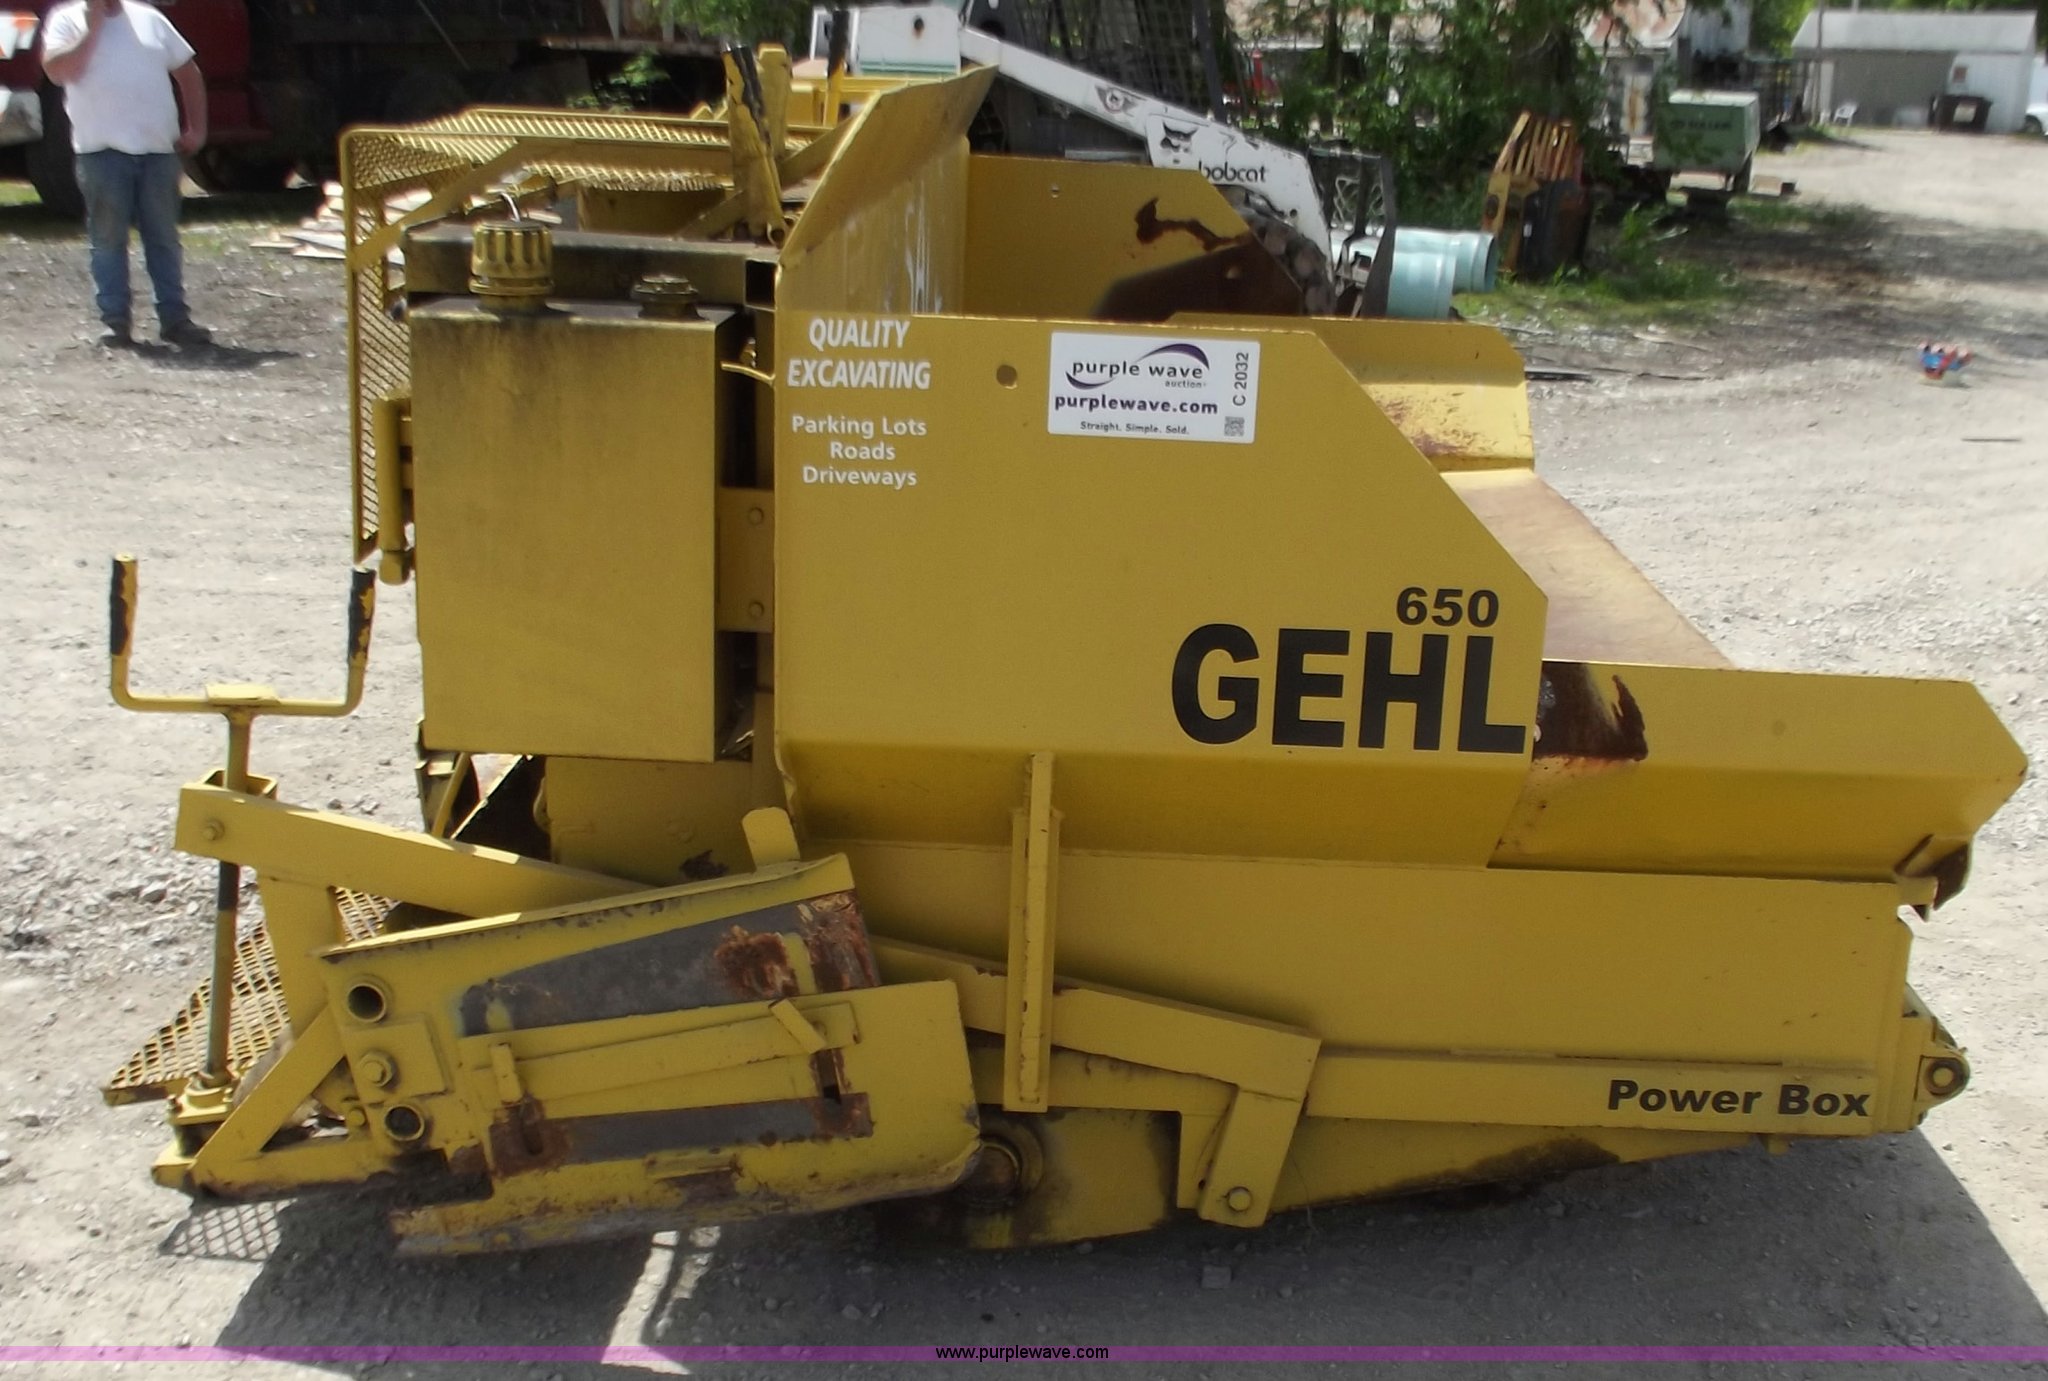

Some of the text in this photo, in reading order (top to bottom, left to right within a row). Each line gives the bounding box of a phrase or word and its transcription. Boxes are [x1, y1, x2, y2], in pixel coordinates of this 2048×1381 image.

[1199, 160, 1267, 183] bobcat
[808, 318, 911, 351] QUALITY
[787, 359, 931, 390] EXCAVATING
[1072, 360, 1203, 379] purple wave
[1233, 352, 1249, 406] C 2032
[1055, 394, 1218, 414] purplewave.com
[792, 415, 927, 439] Parking Lots
[1080, 421, 1190, 435] Straight. Simple. Sold.
[830, 440, 896, 460] Roads
[802, 466, 917, 490] Driveways
[1396, 586, 1499, 628] 650
[1172, 623, 1526, 754] GEHL
[1608, 1079, 1871, 1117] Power Box
